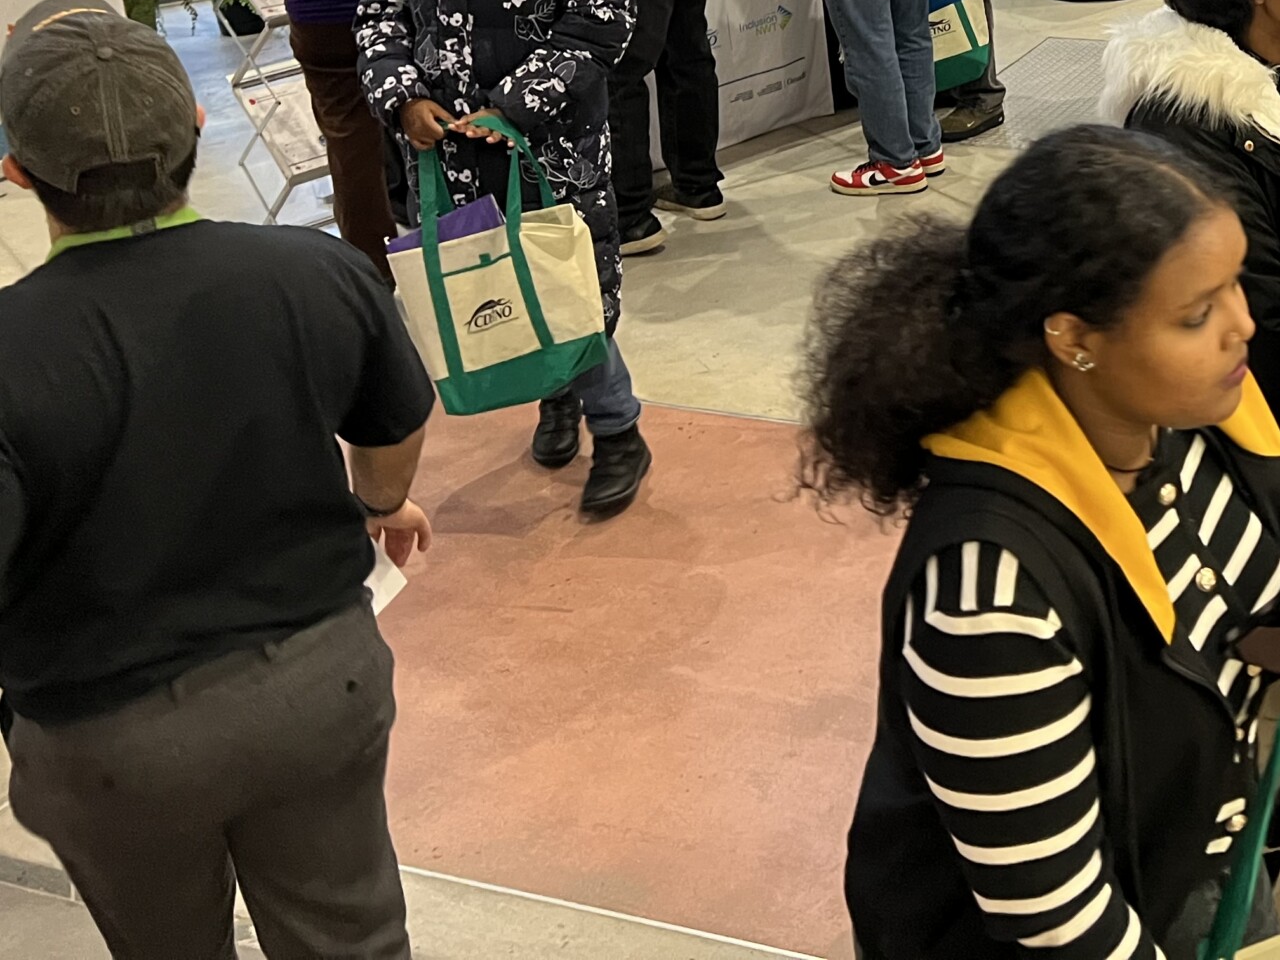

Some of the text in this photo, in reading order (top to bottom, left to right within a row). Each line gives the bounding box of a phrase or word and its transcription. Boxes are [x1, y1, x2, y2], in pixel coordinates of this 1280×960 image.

[739, 11, 778, 38] Inclusion NWT
[931, 23, 951, 35] TNO
